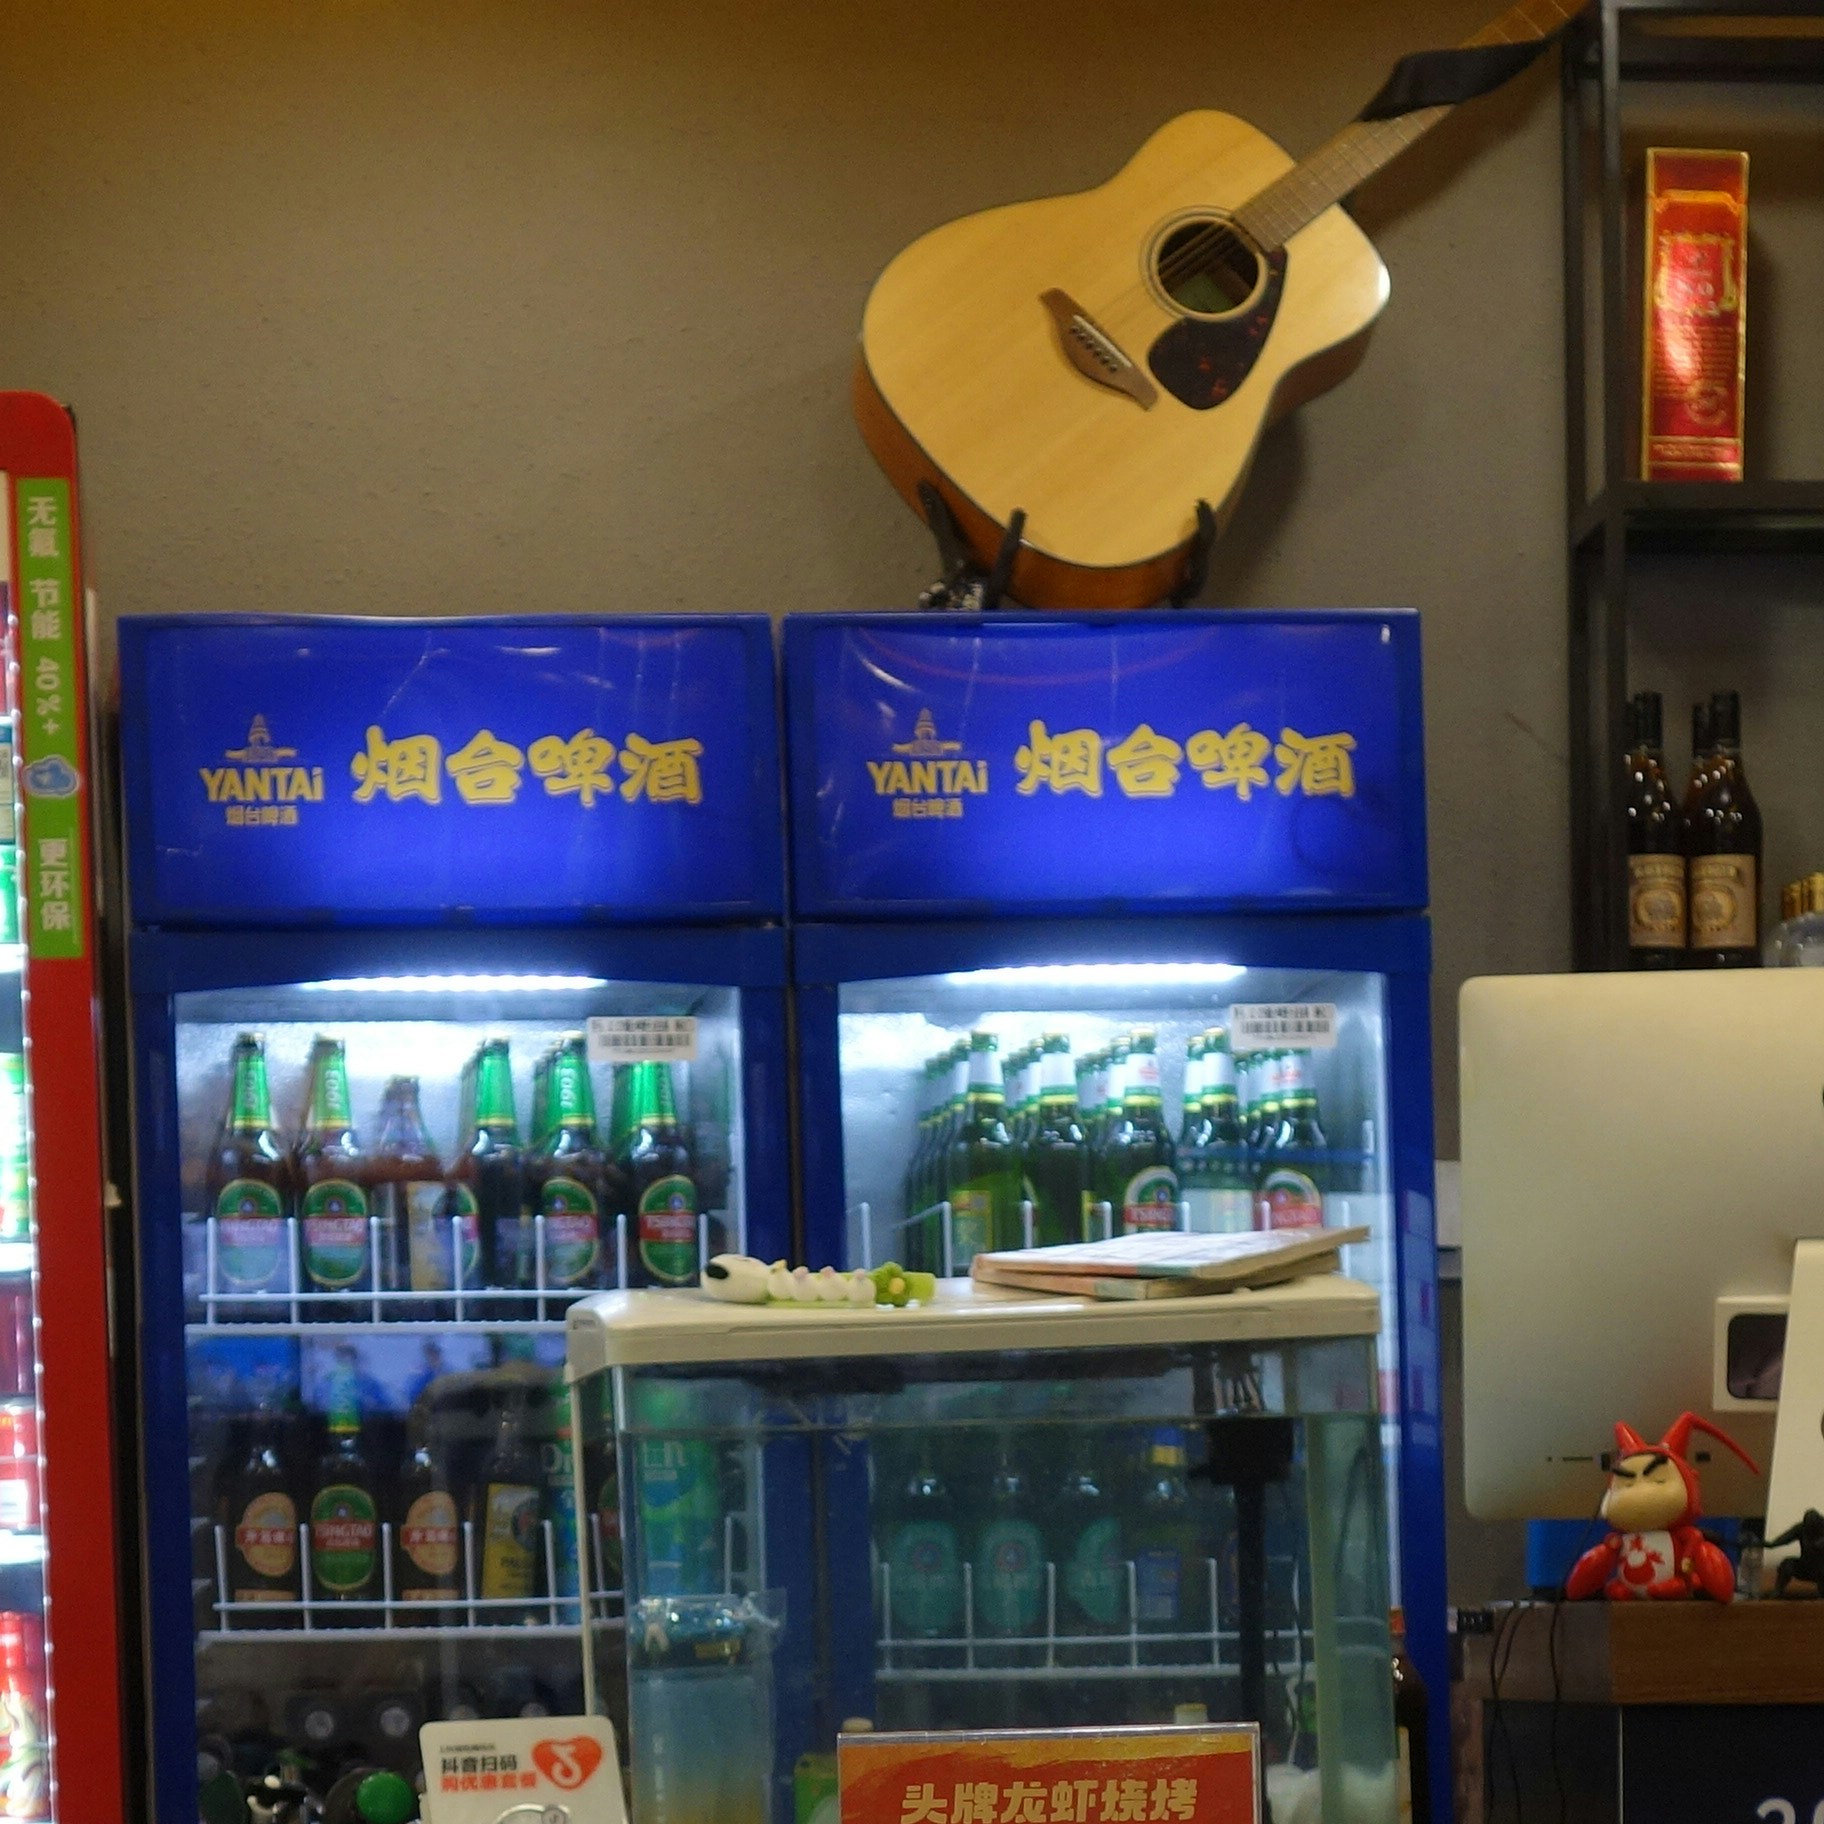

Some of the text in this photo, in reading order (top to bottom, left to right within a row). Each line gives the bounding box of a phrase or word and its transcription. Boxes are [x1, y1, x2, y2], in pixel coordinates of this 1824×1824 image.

[28, 578, 62, 640] 节能
[350, 725, 705, 808] 烟台啤酒
[1014, 720, 1357, 801] 烟台啤酒
[38, 838, 71, 931] 更环保
[440, 1755, 518, 1774] 抖音扫码
